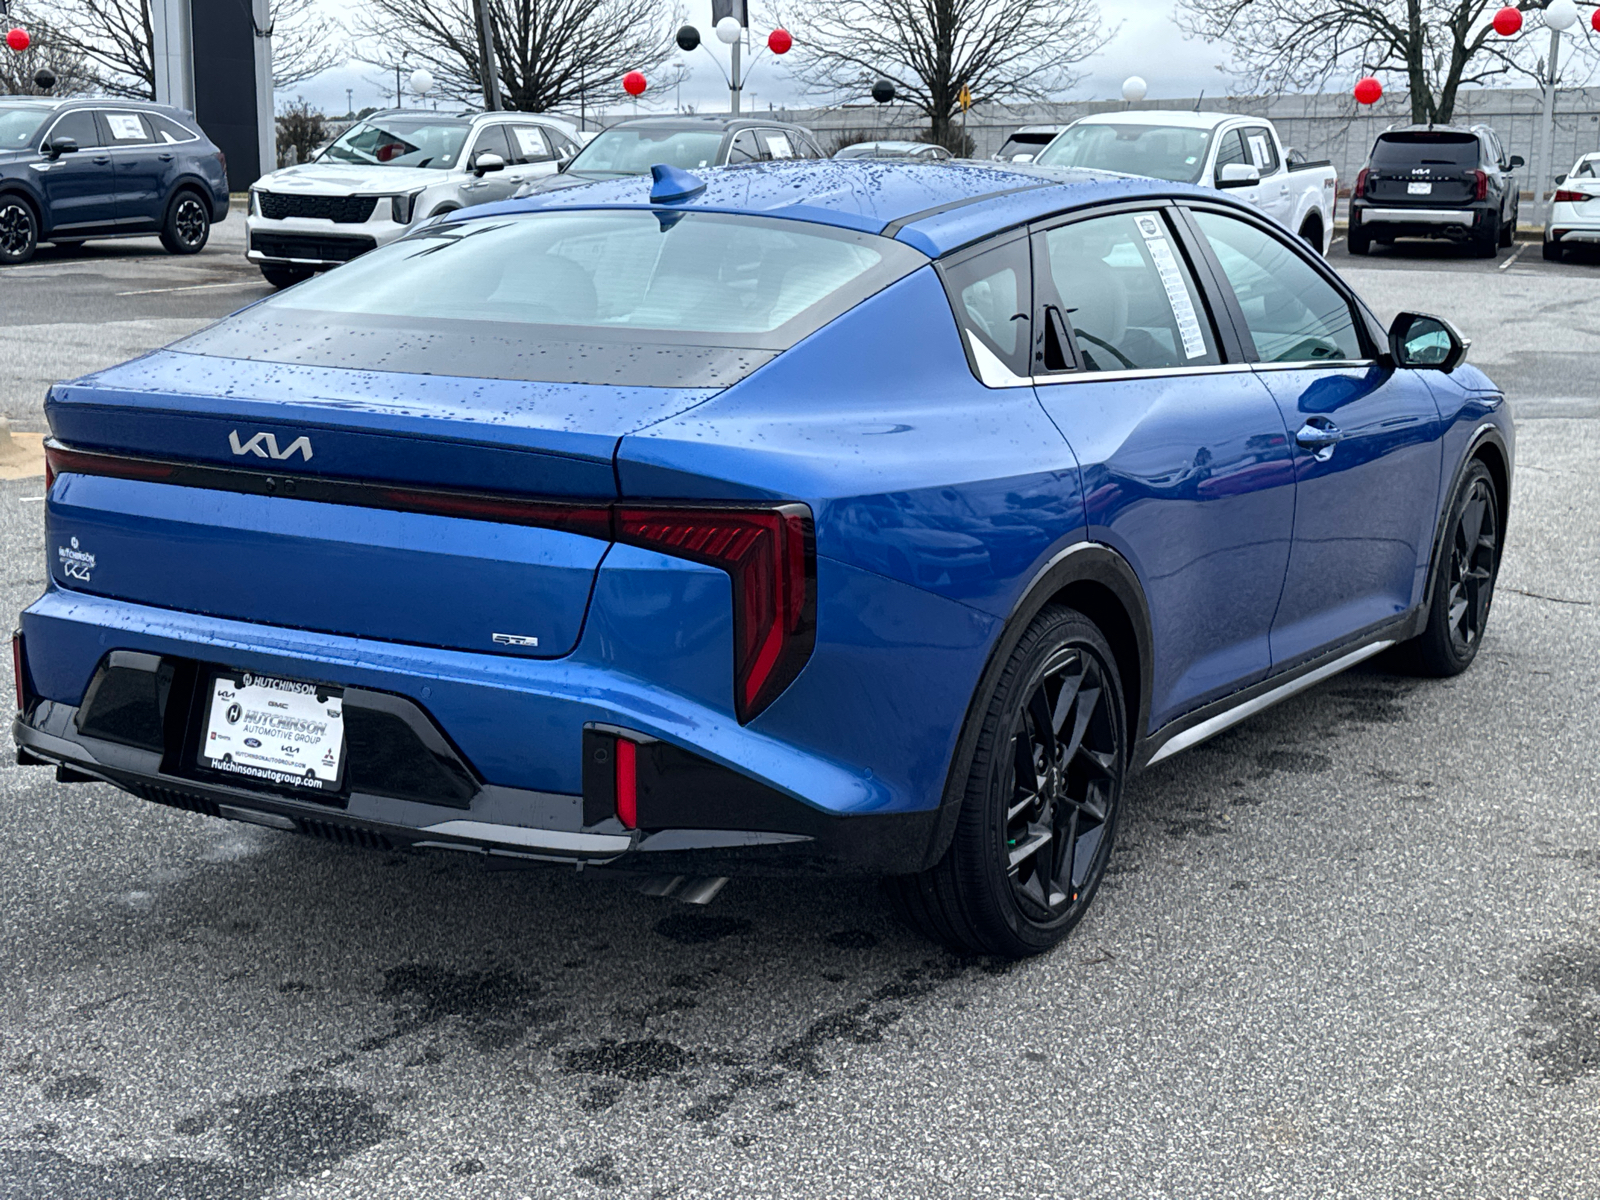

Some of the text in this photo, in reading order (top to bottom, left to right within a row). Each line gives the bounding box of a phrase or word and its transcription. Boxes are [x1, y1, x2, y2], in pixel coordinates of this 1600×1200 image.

[228, 429, 313, 462] KIA
[217, 690, 235, 699] KIA
[254, 676, 317, 696] HUTCHINSON
[268, 700, 289, 709] GMC
[243, 709, 327, 736] HUTCHINSON
[243, 724, 321, 744] AUTOMOTIVE GROUP
[281, 745, 299, 753] KIA
[211, 758, 322, 789] Hutchinsonautogroup.com
